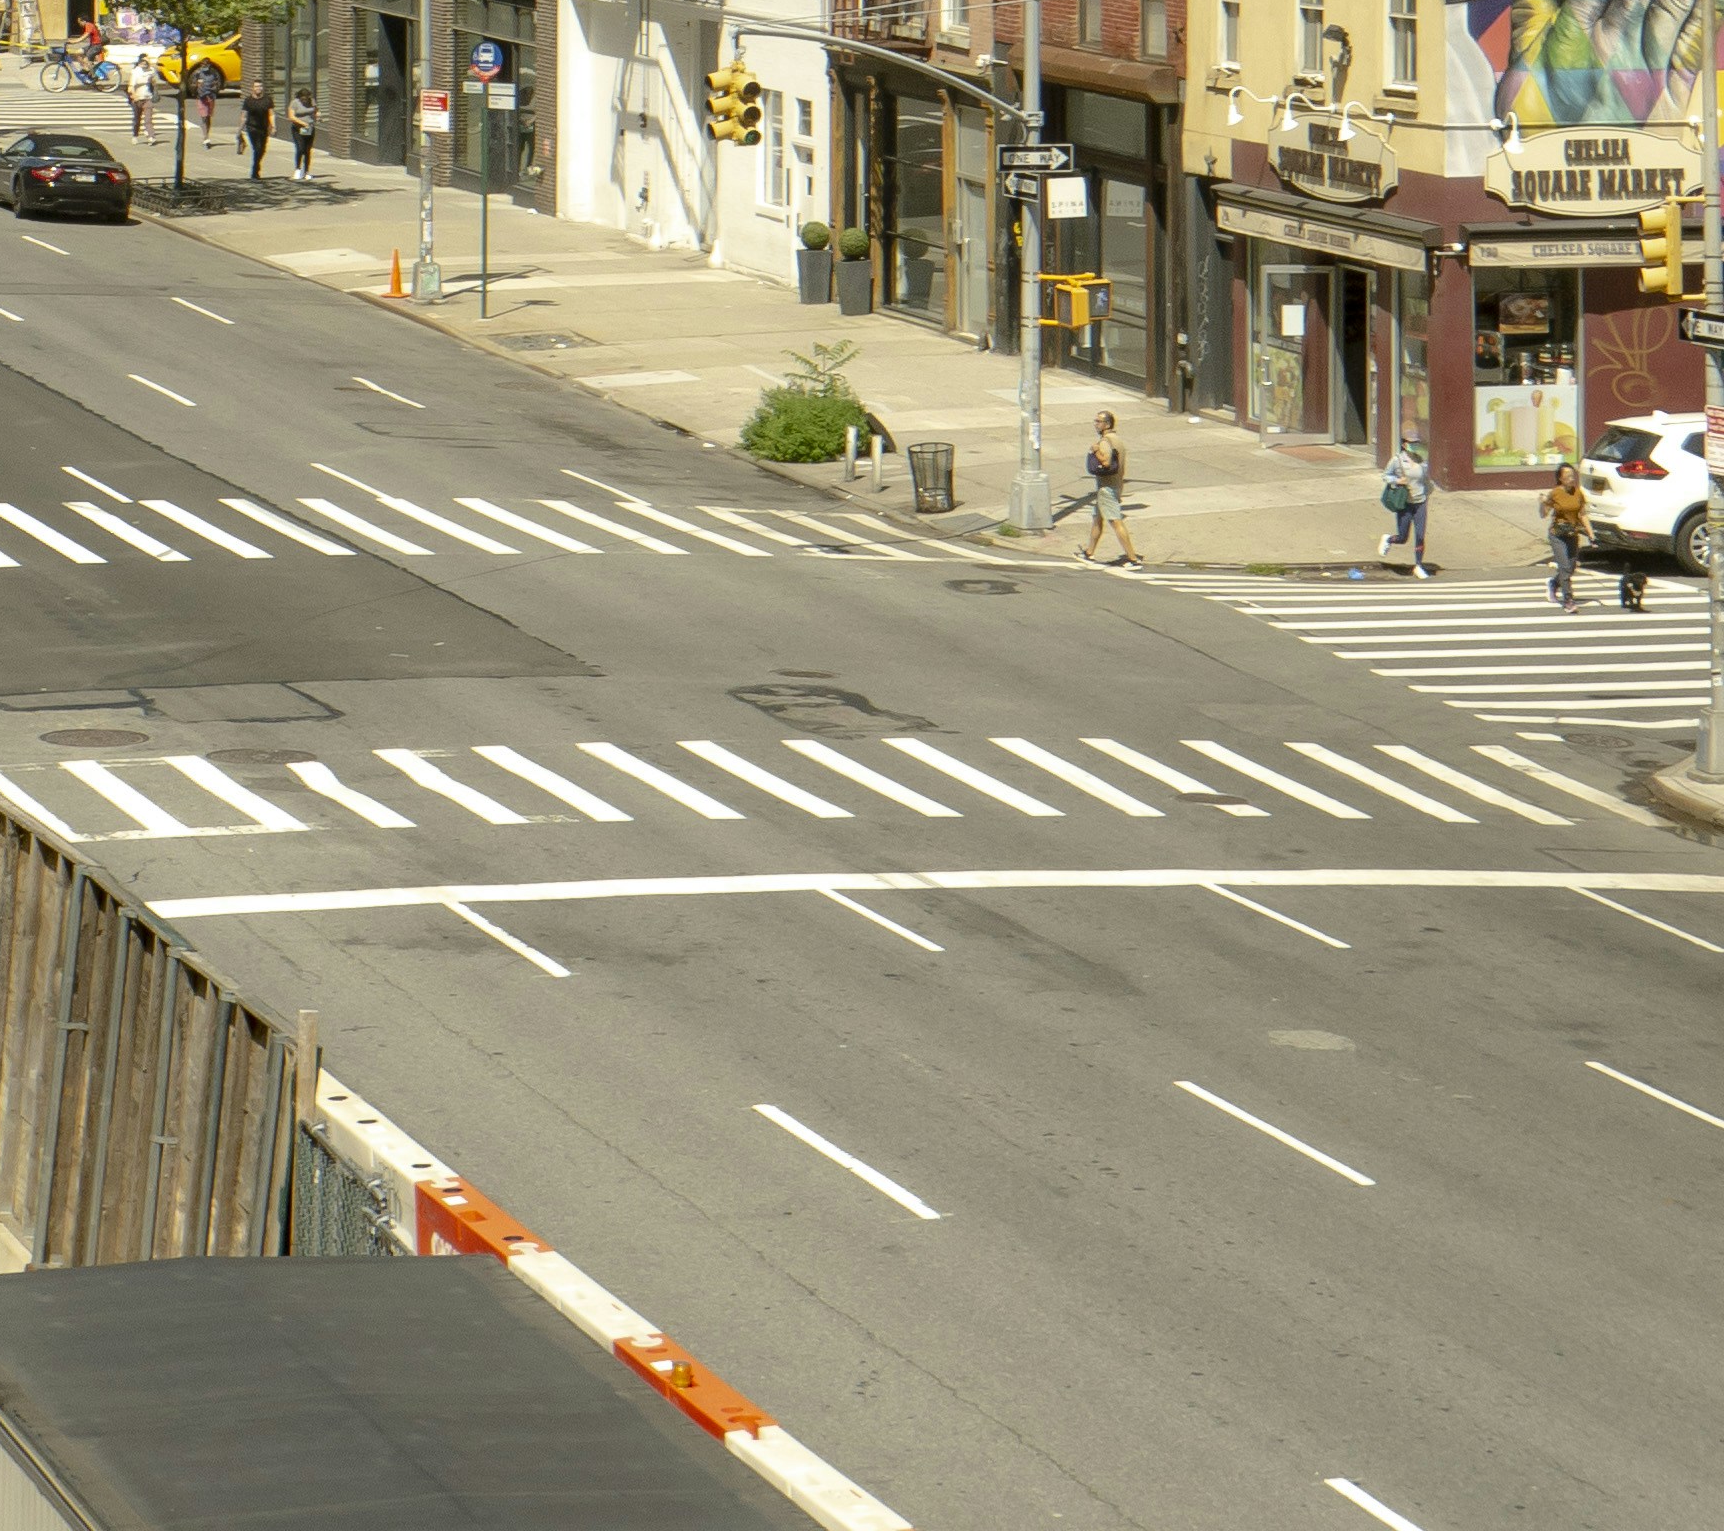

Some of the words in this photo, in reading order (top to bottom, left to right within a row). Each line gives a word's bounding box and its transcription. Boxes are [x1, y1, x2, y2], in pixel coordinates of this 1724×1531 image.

[1007, 153, 1031, 164] ONE
[1039, 153, 1061, 163] WAY
[1564, 138, 1630, 163] CHELSEA
[1512, 169, 1591, 202] SQUARE
[1598, 168, 1684, 201] MARKET
[1531, 244, 1585, 257] CHELSEA
[1587, 243, 1633, 257] SQUARE
